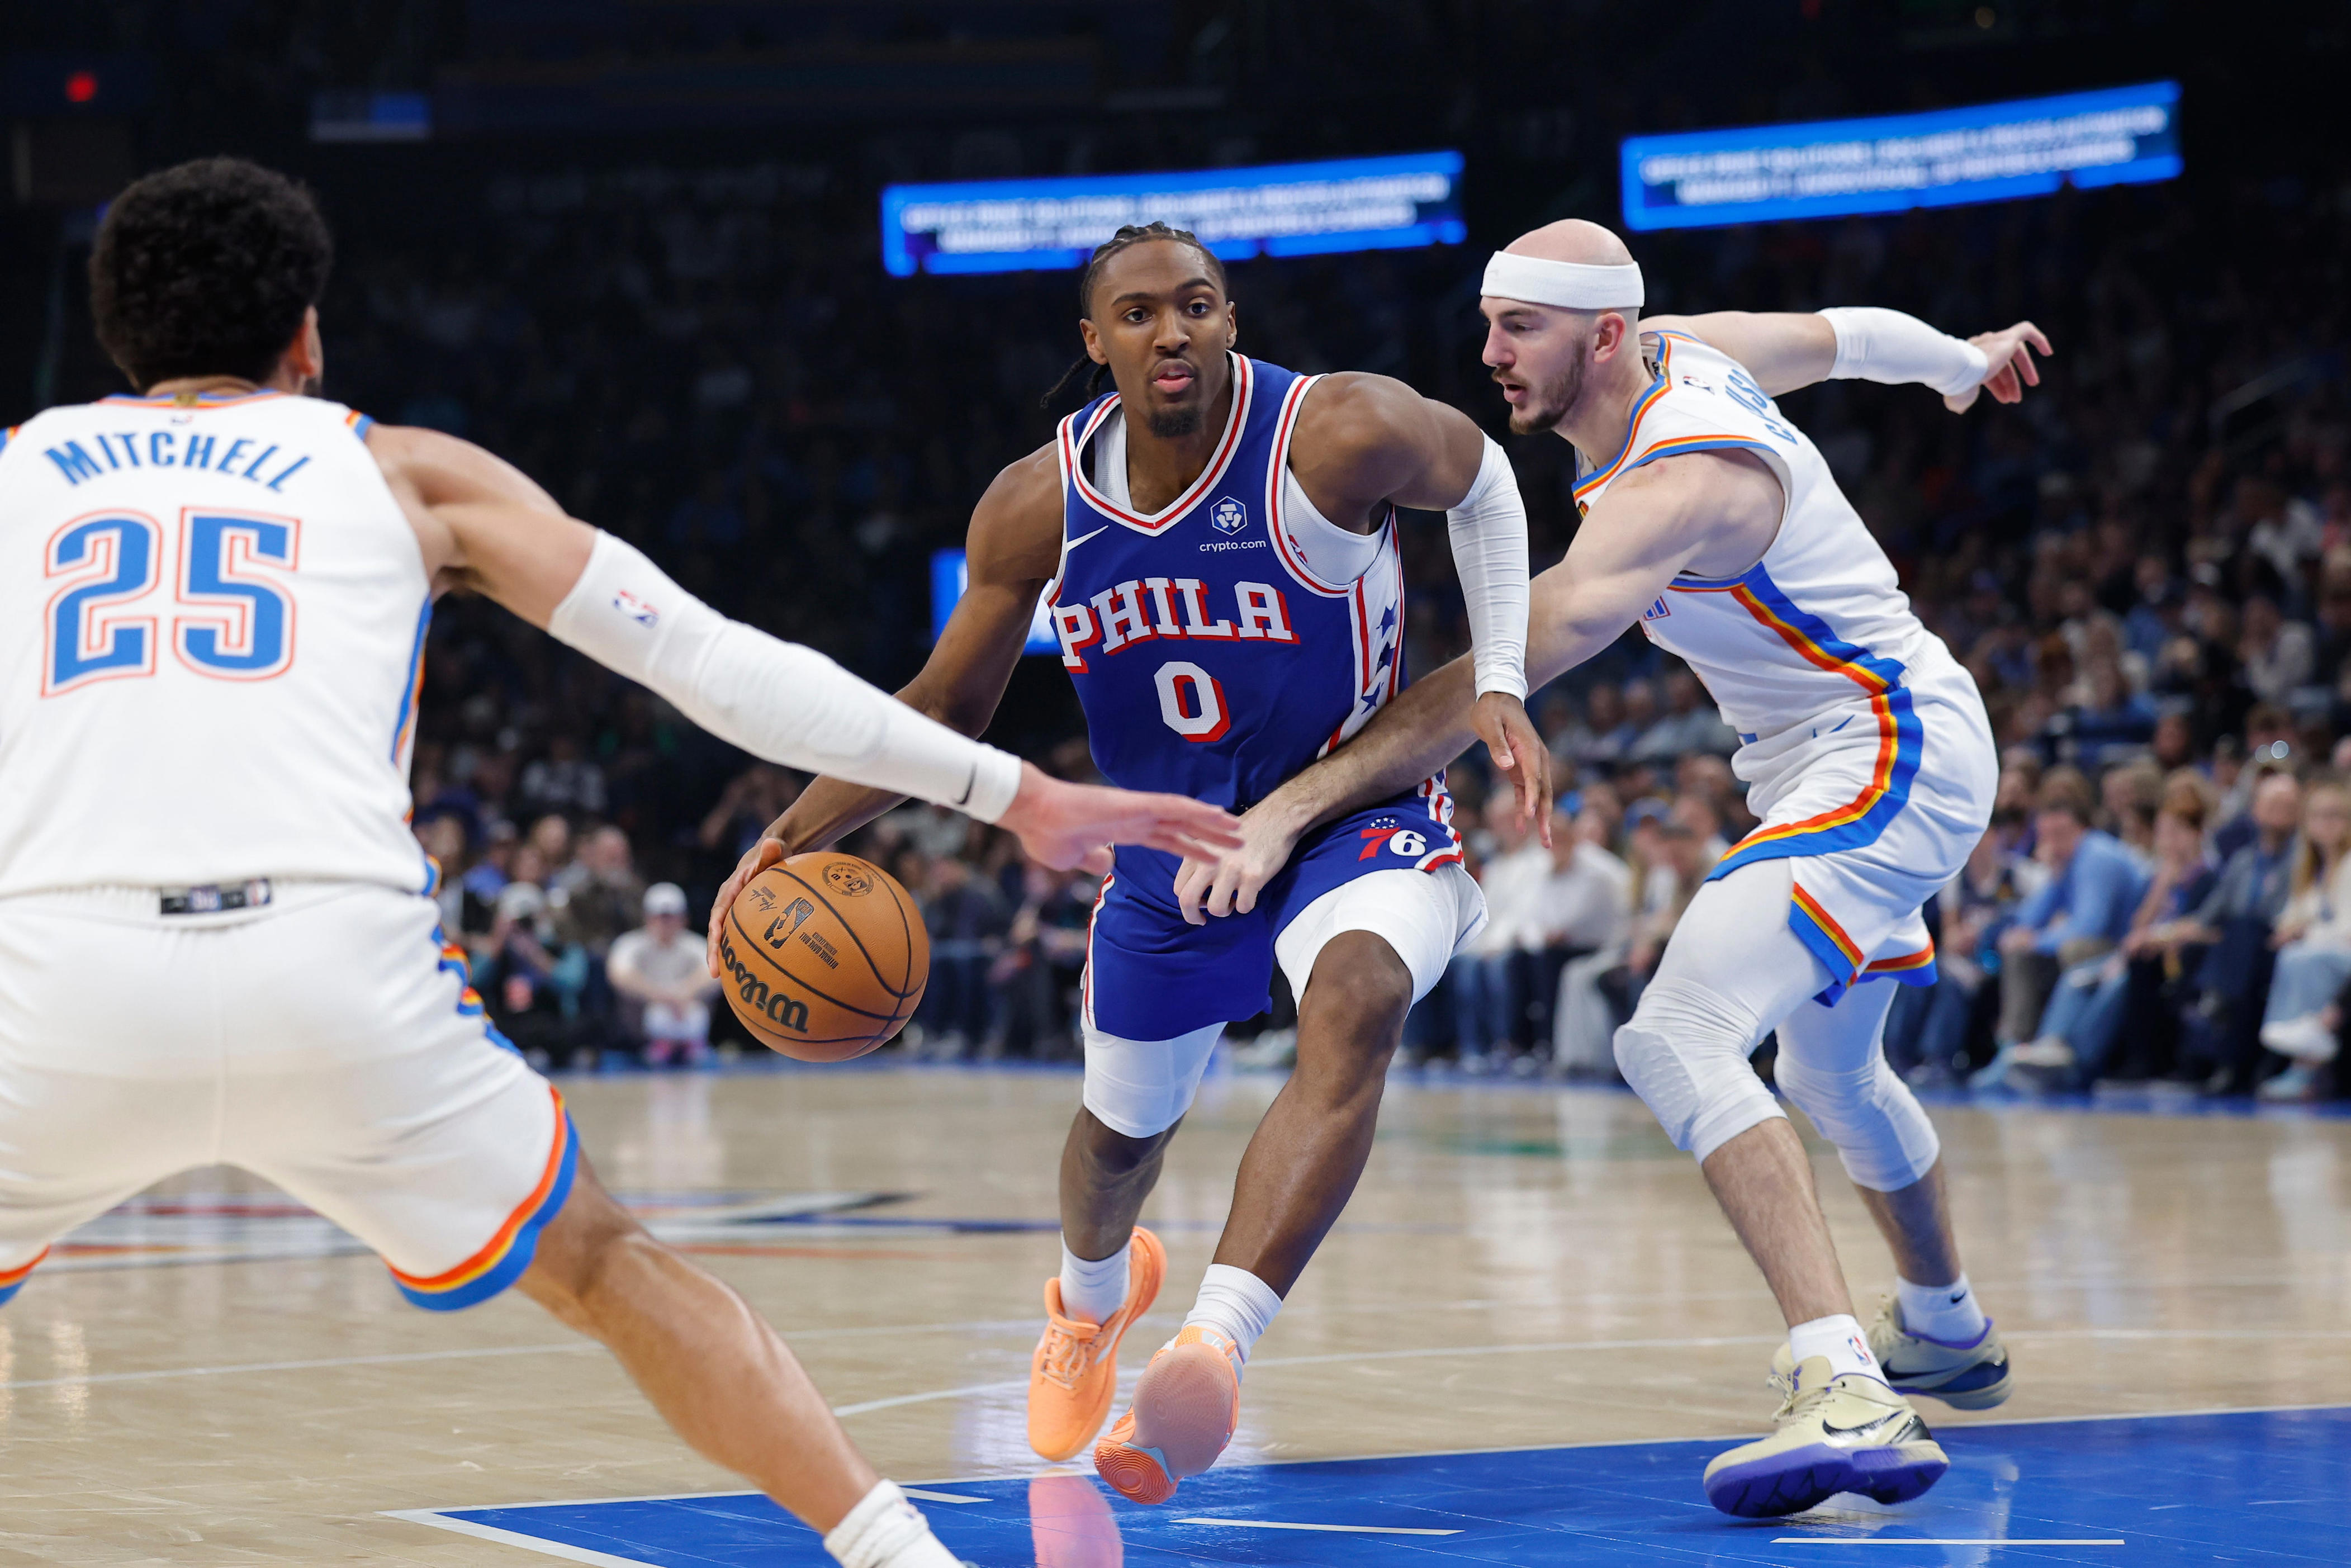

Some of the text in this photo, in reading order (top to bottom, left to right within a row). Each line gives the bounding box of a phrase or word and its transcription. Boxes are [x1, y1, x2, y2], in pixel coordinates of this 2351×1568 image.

[44, 432, 312, 494] MITCHELL
[1199, 540, 1267, 552] crypto.com
[40, 505, 301, 699] 25
[1053, 577, 1301, 674] PHILA
[1153, 661, 1231, 743] 0
[1358, 827, 1426, 862] 76
[721, 925, 809, 1033] Wilson
[799, 931, 839, 969] OFFICIAL GAME BALL
